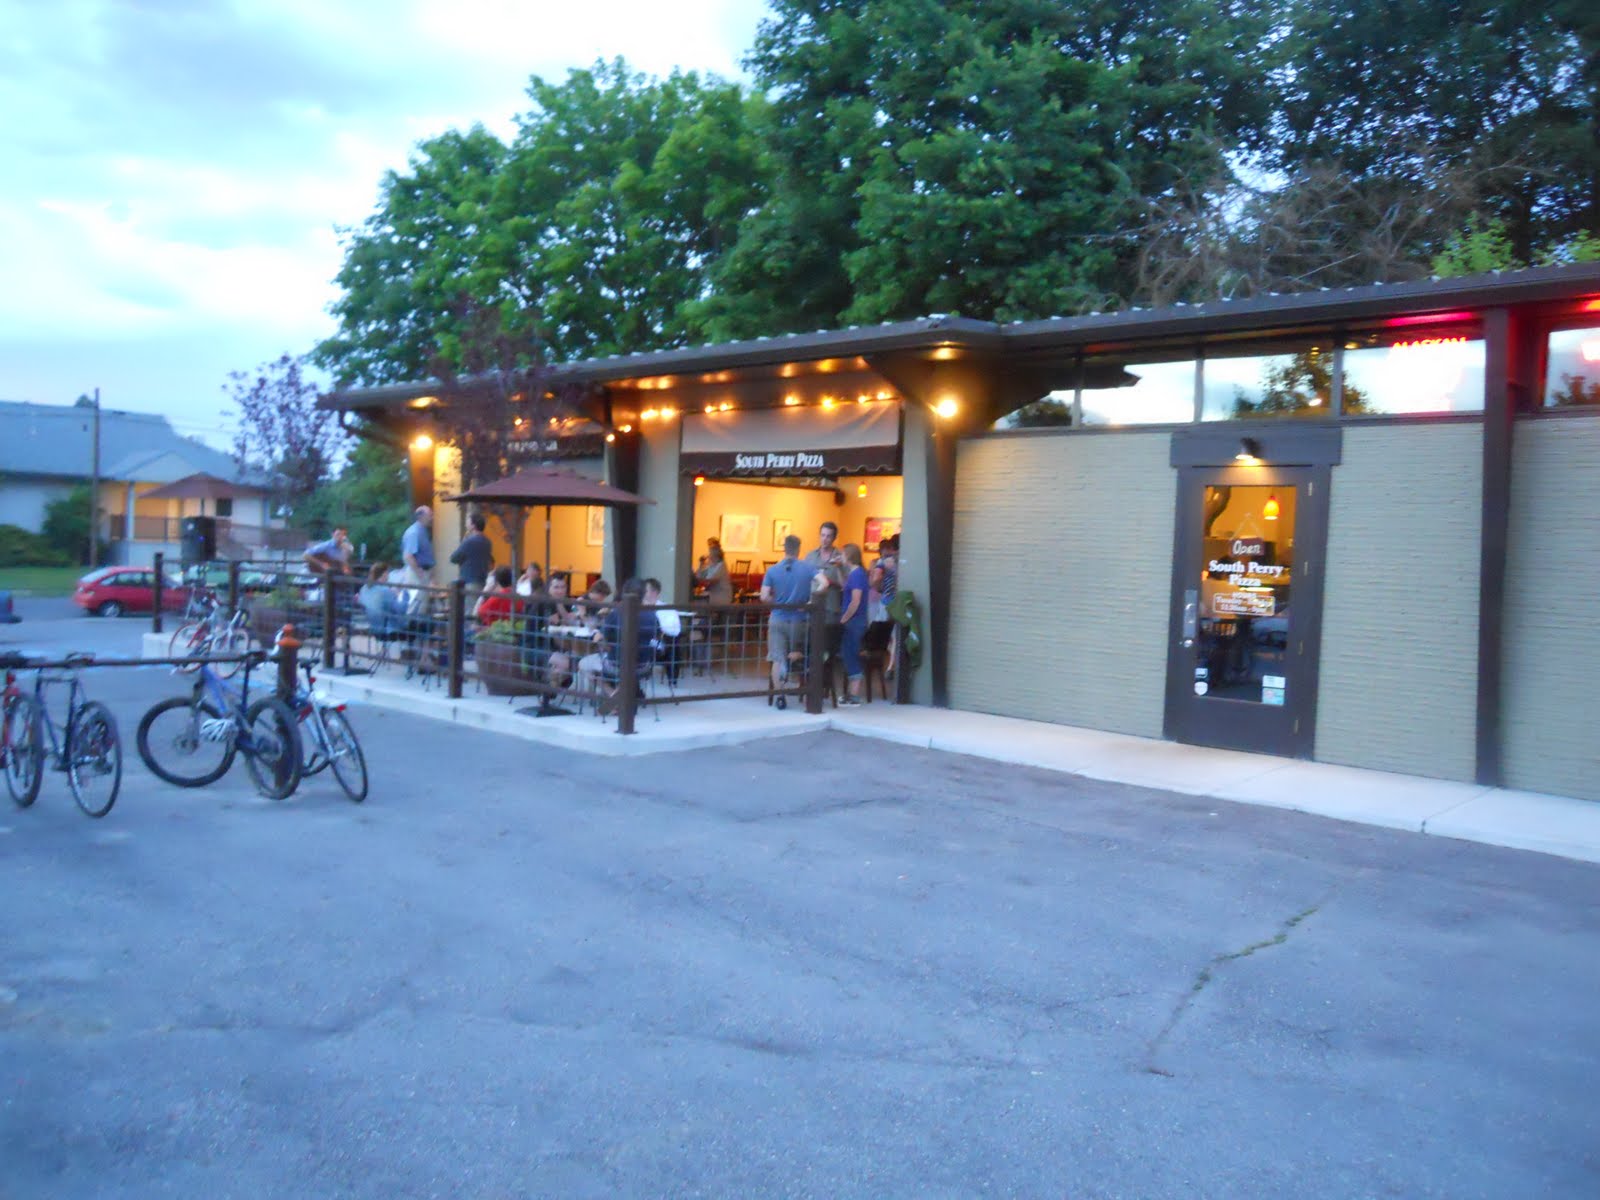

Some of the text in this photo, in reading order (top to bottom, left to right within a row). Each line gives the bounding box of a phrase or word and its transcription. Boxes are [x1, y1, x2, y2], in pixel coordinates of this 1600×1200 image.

[735, 452, 824, 468] SOUTH PERRY PIZZA
[1232, 540, 1260, 554] Open
[1208, 560, 1284, 578] South Perry
[1229, 574, 1262, 586] Pizza
